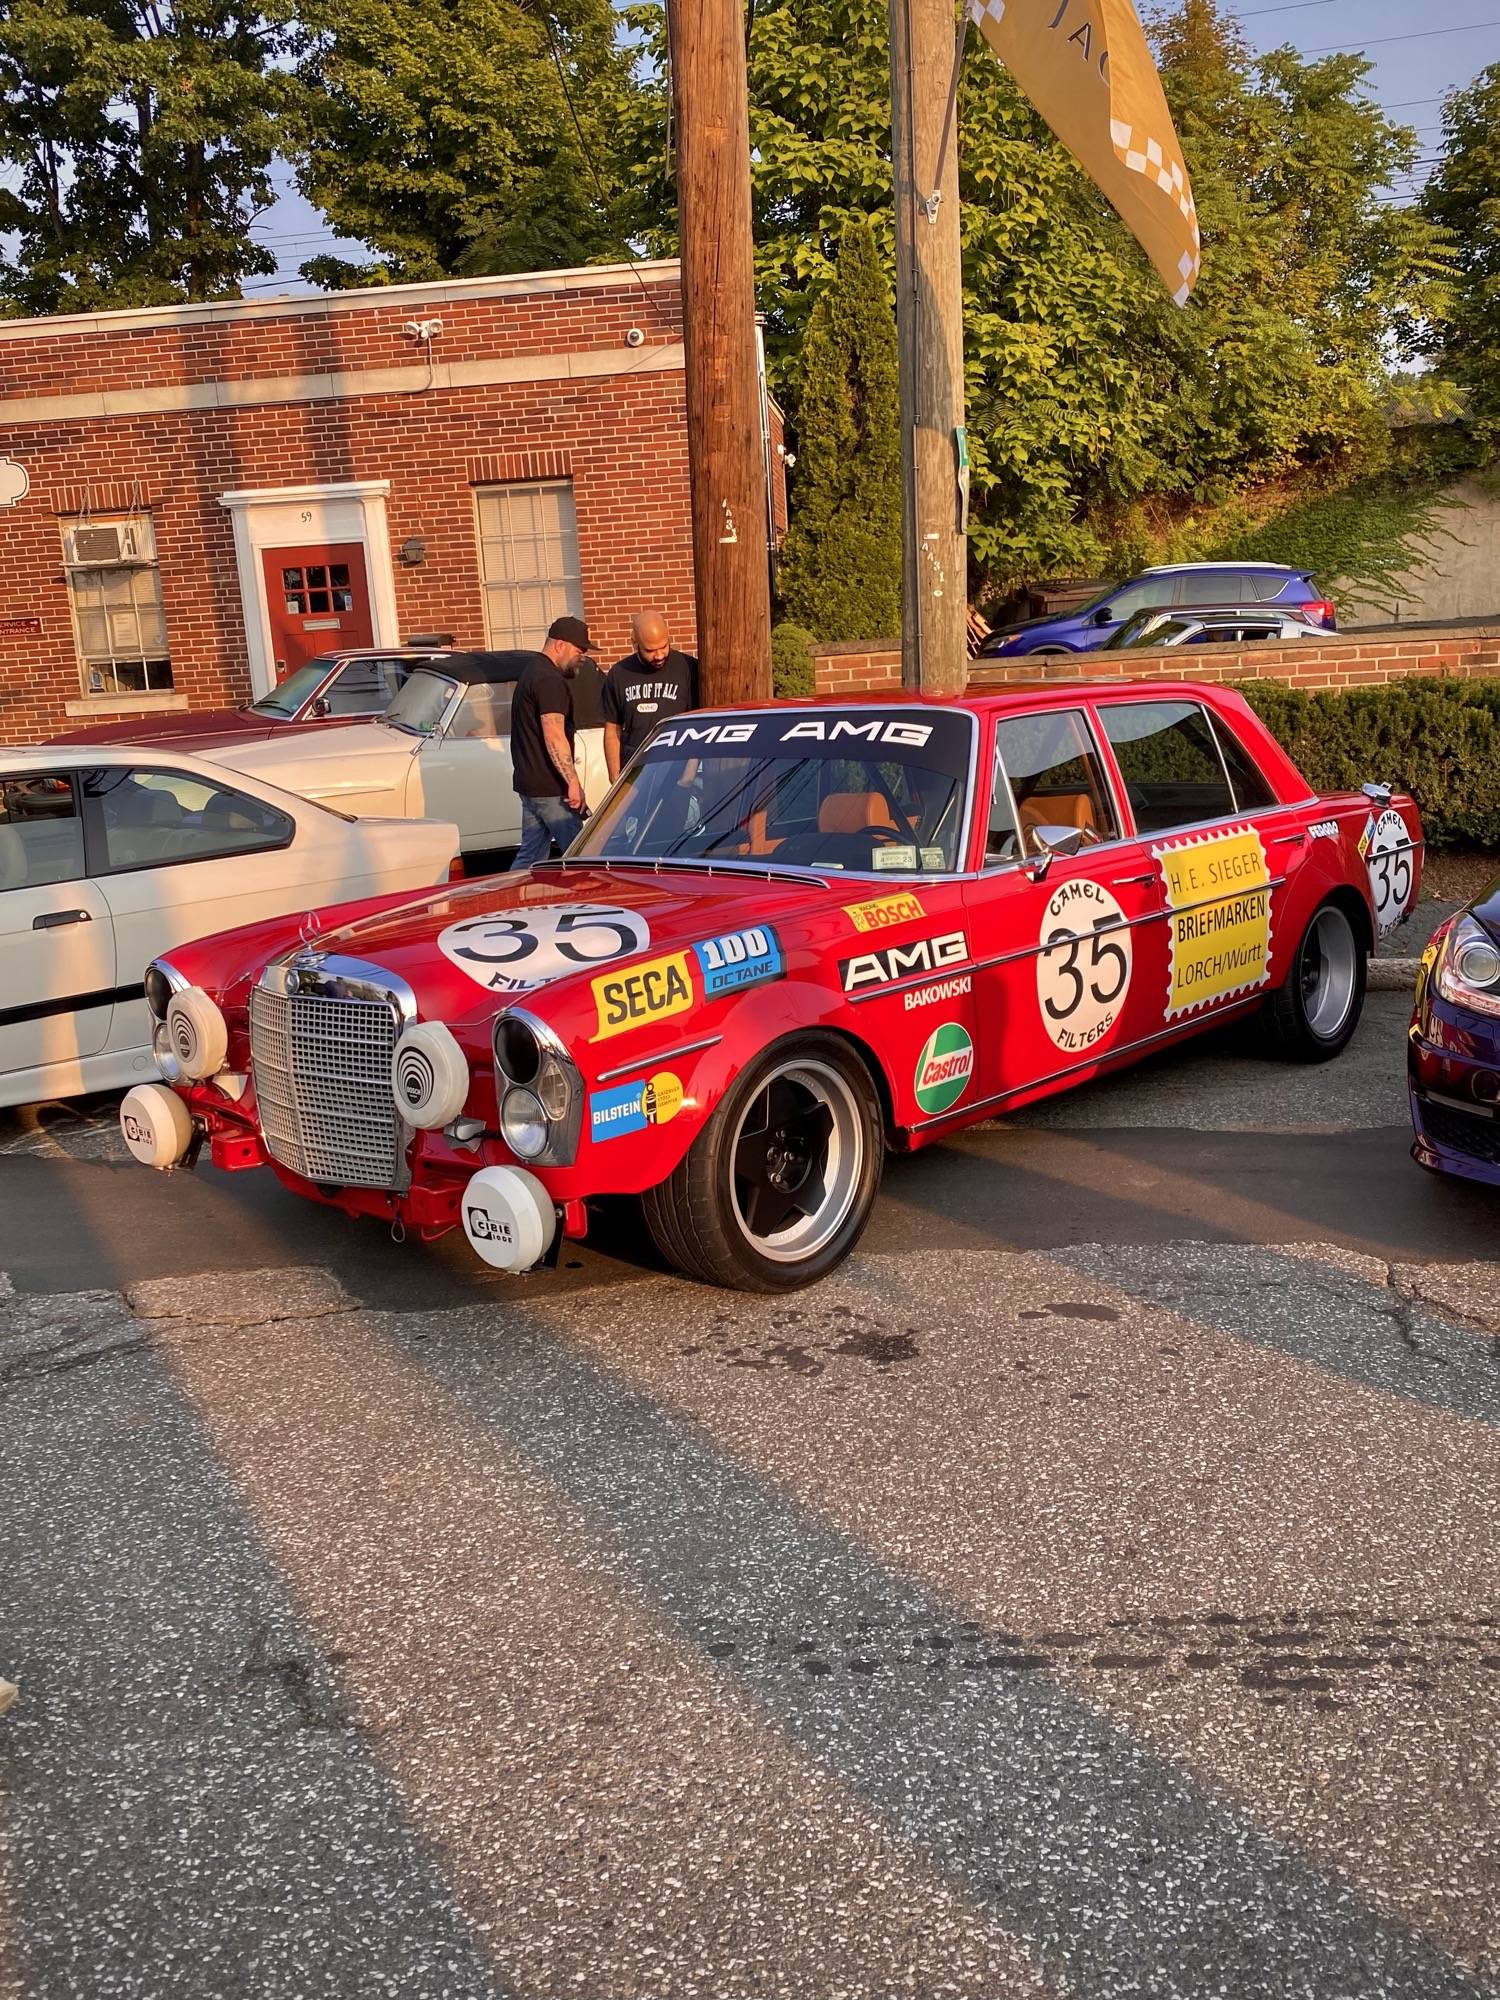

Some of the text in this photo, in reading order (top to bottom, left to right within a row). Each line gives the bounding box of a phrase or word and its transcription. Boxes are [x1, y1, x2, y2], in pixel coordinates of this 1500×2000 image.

[301, 511, 312, 522] 59
[625, 683, 678, 702] SICK OF IT ALL
[646, 721, 933, 750] AMG AMG
[1377, 813, 1402, 835] CAMEL
[1209, 852, 1261, 884] SIEGER
[1373, 838, 1410, 912] 35
[863, 900, 921, 928] BOSCH
[1050, 883, 1105, 916] CAMEL
[1178, 894, 1265, 942] BRIEFMARKEN
[453, 910, 637, 963] 35
[702, 928, 768, 970] 100
[712, 960, 773, 989] OCTANE
[844, 931, 968, 992] AMG
[1044, 912, 1127, 1020] 35
[603, 965, 689, 1025] SECA
[904, 976, 971, 1010] BAKOWSKI
[1057, 1012, 1113, 1048] FILTERS
[923, 1050, 972, 1086] Castrol
[593, 1100, 640, 1125] BILSTEIN
